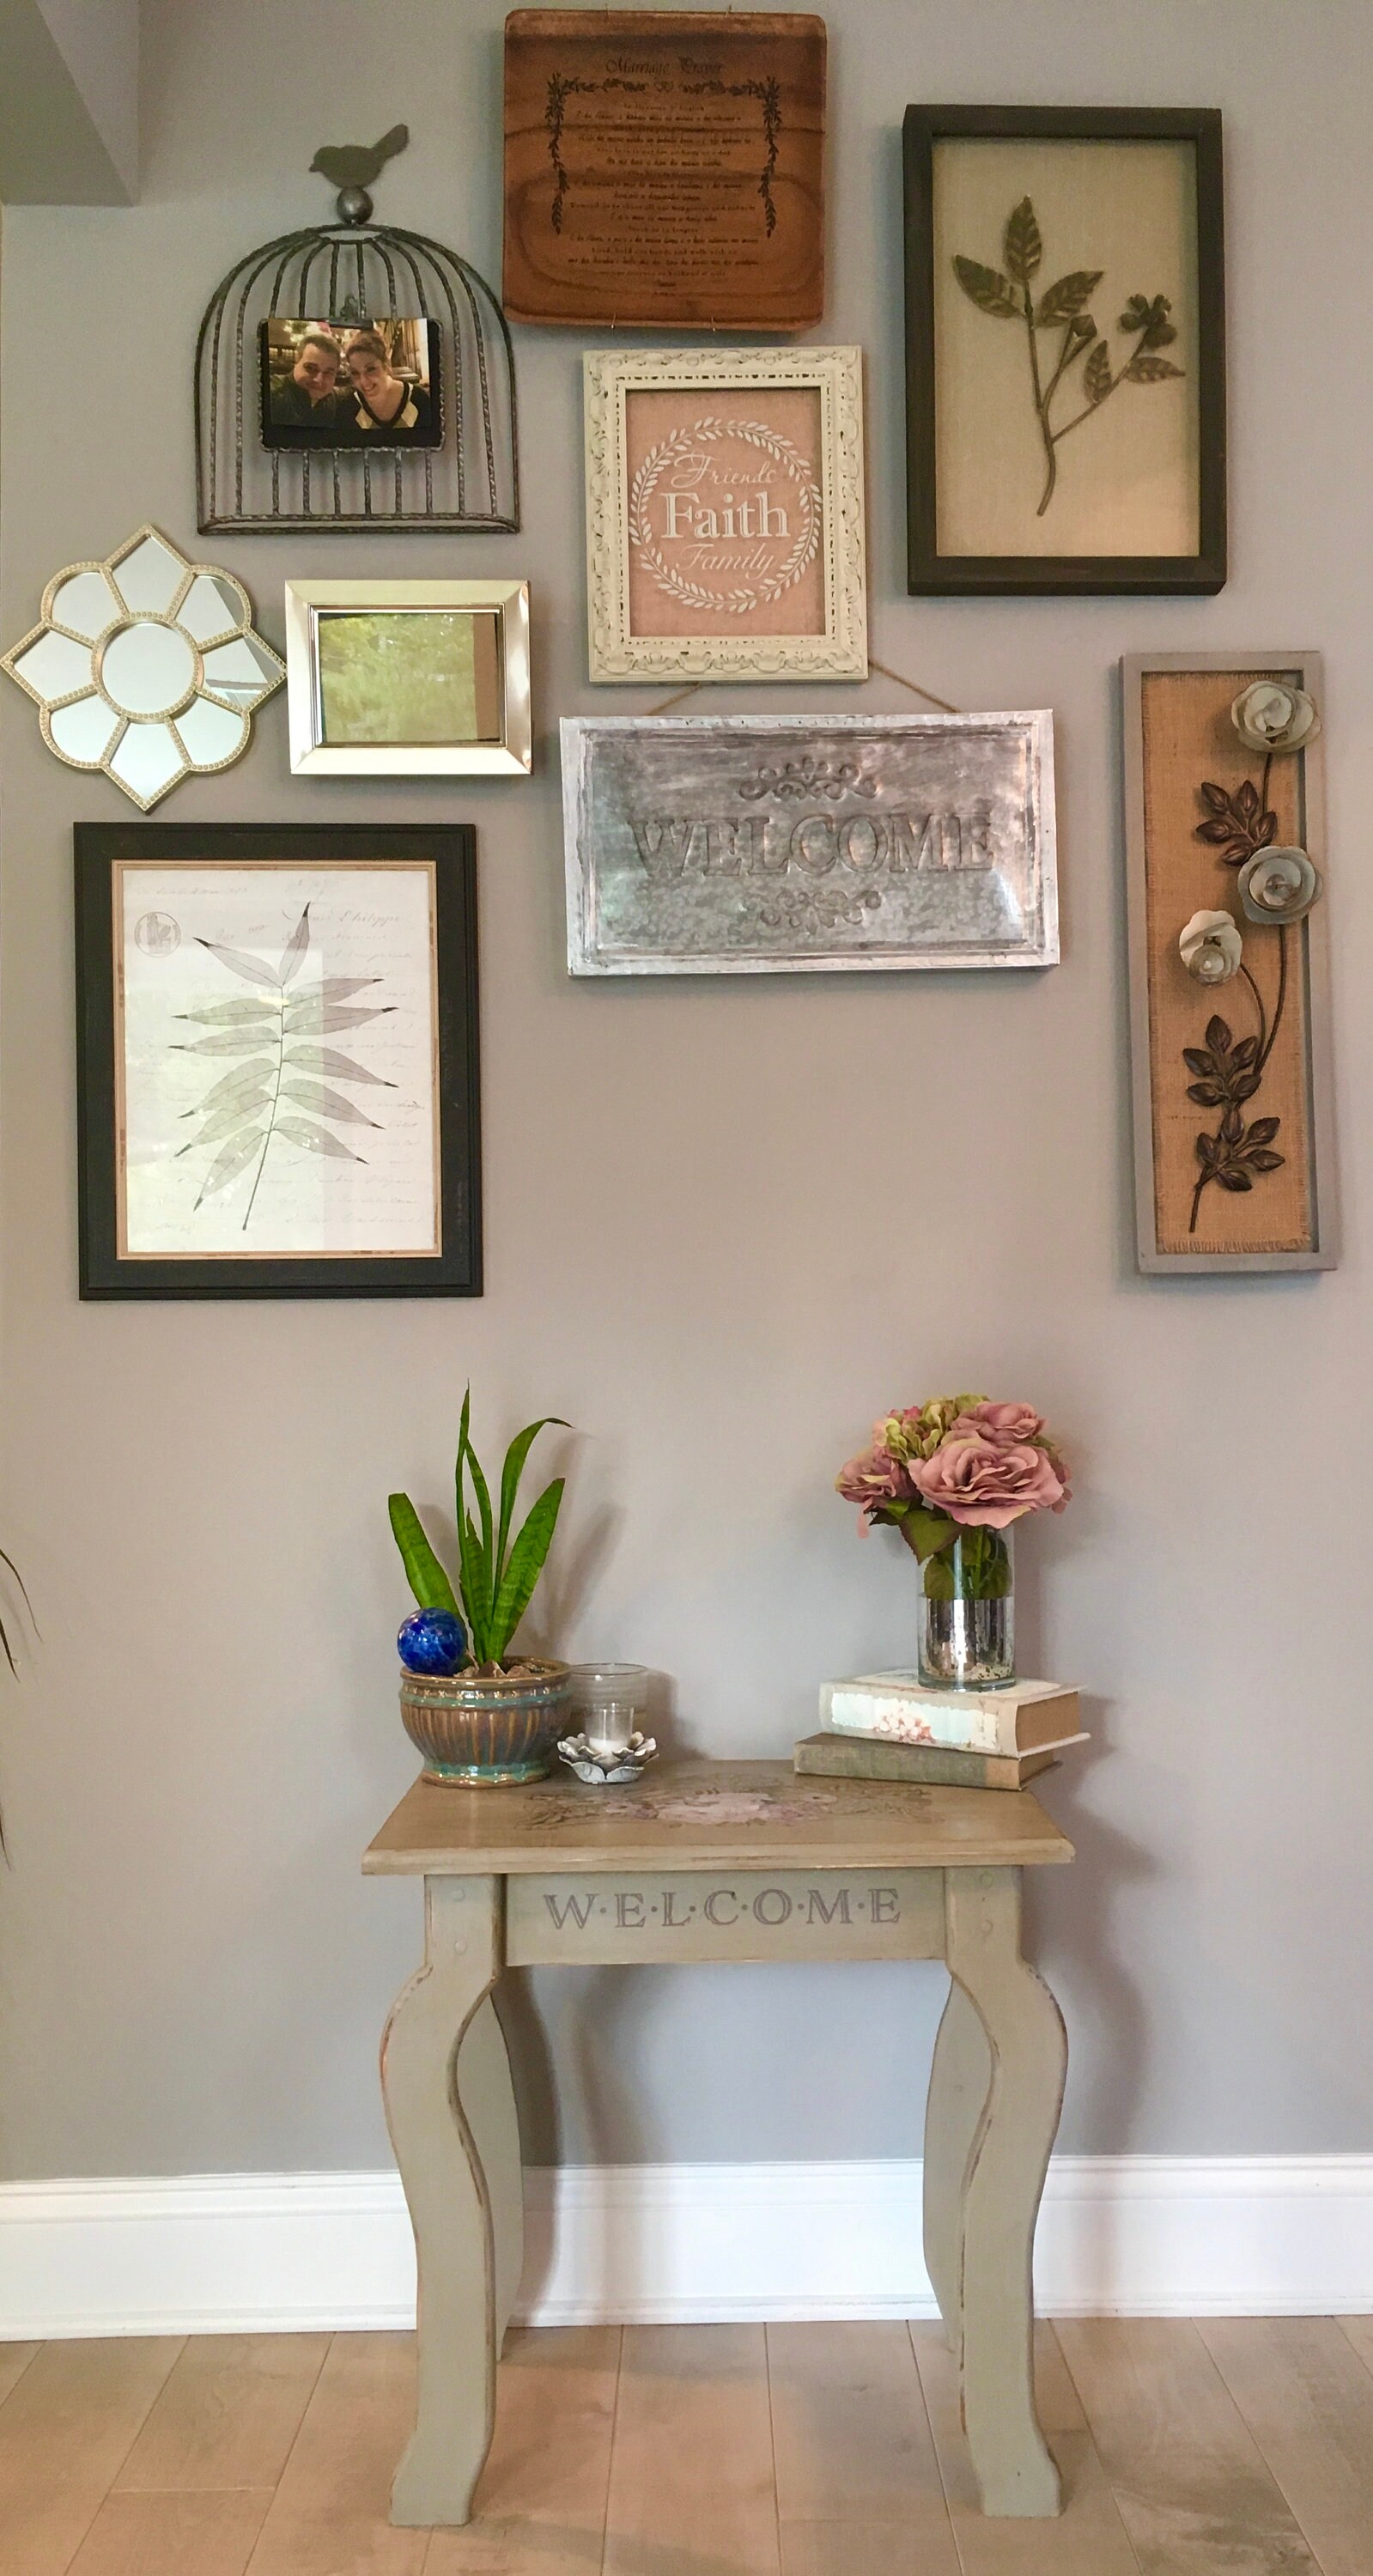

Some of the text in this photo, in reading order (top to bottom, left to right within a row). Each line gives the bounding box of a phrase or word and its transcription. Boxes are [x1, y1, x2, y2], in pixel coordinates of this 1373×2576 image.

[671, 449, 777, 489] Friends
[659, 491, 791, 538] Faith
[676, 543, 778, 580] Family
[628, 808, 995, 877] WELCOME
